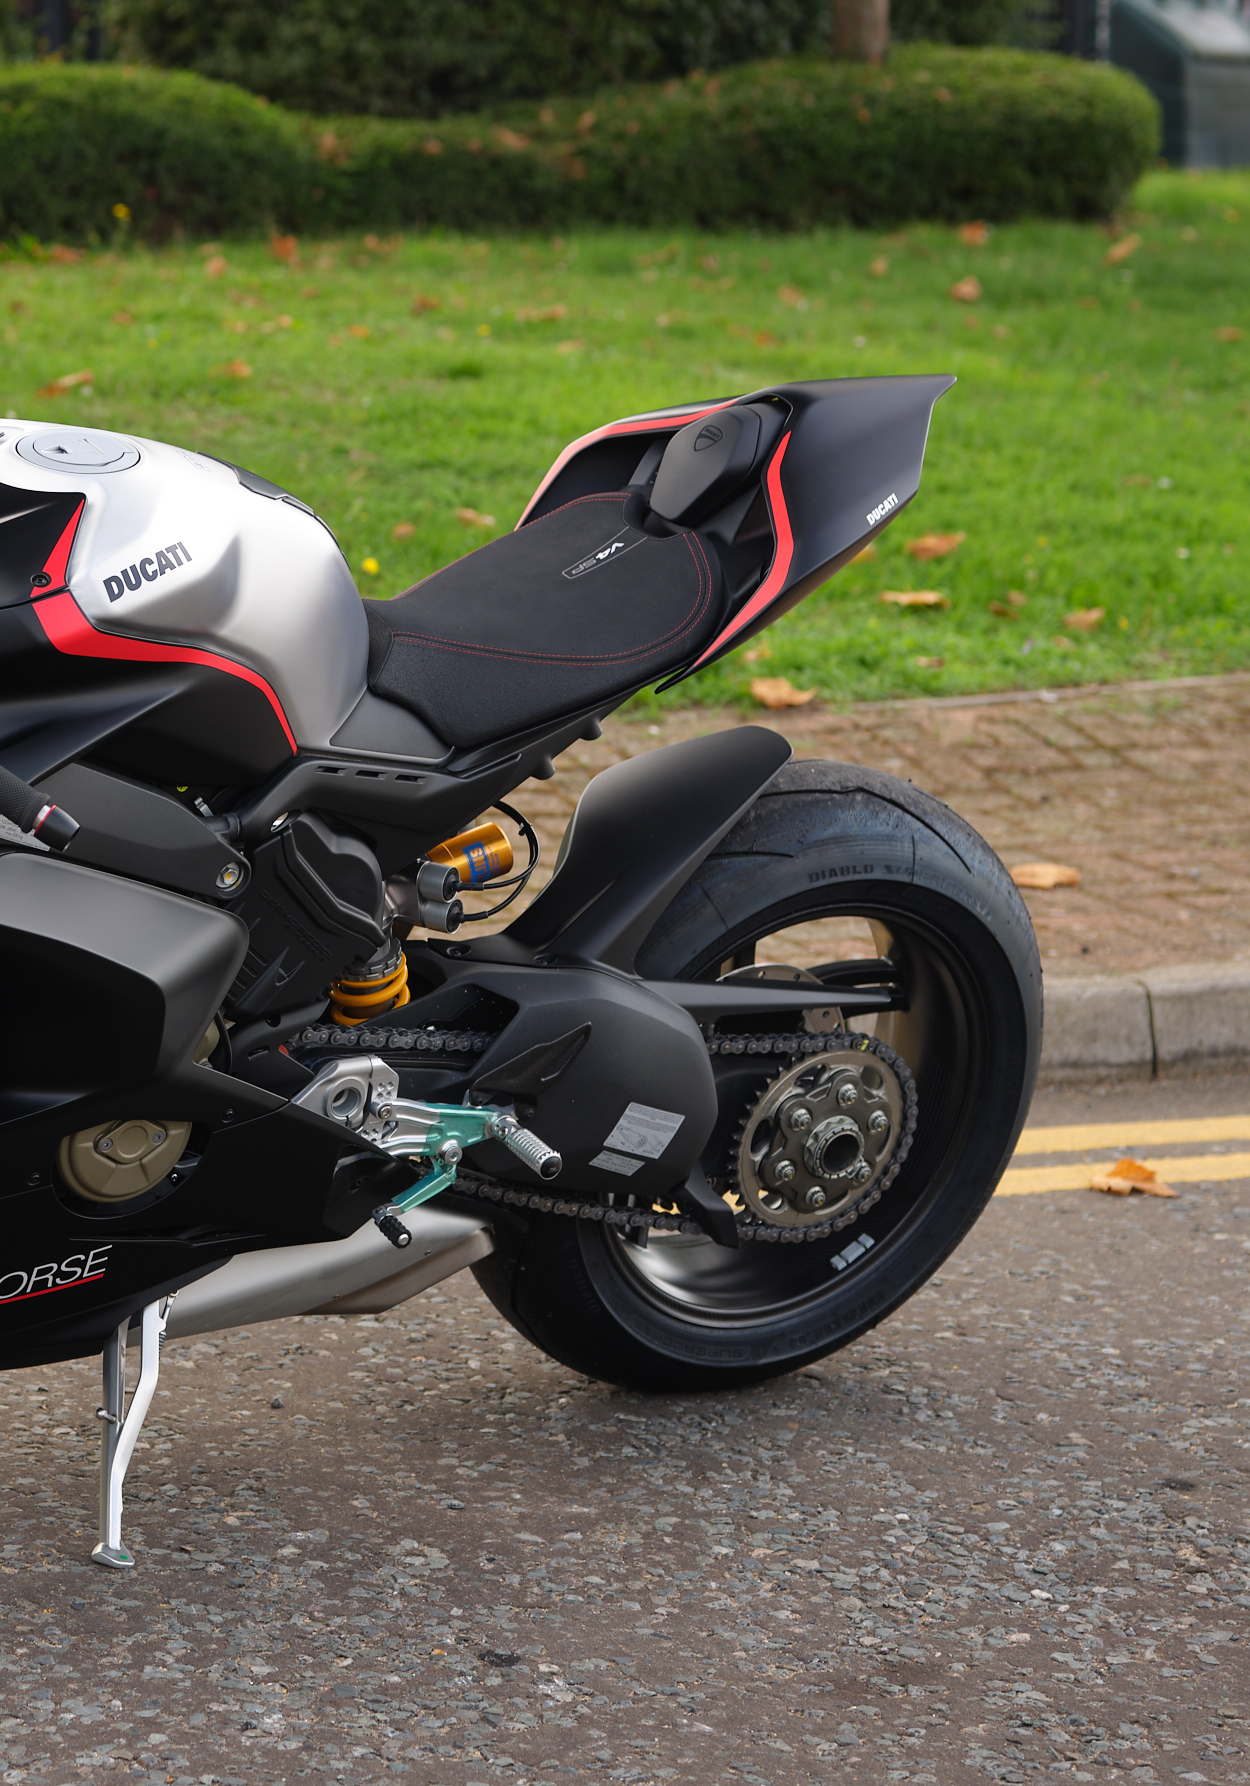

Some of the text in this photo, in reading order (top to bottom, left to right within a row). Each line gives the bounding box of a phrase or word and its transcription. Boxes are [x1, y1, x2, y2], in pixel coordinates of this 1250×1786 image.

[865, 492, 899, 525] DUCATI
[102, 541, 193, 603] DUCATI
[808, 864, 875, 883] DIABLO
